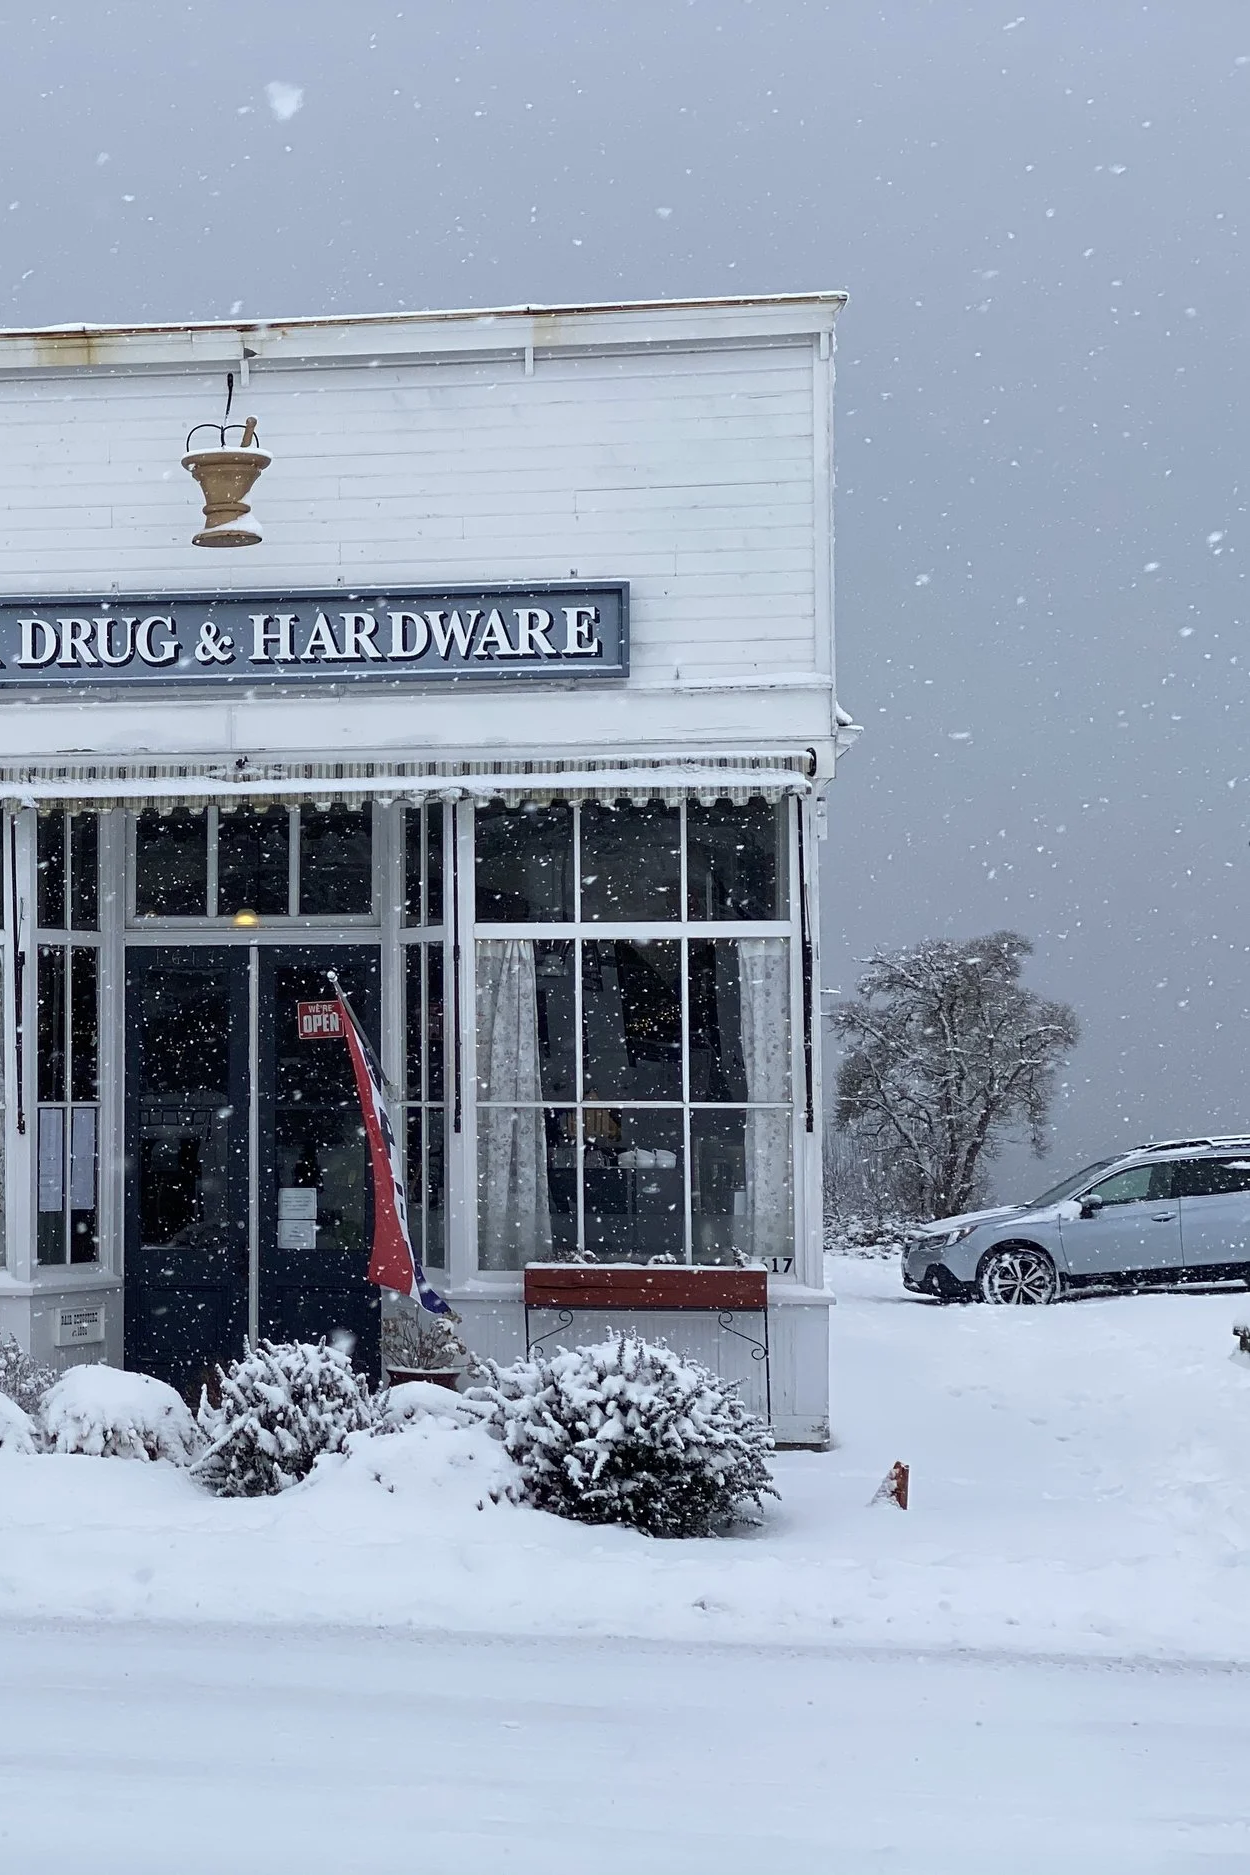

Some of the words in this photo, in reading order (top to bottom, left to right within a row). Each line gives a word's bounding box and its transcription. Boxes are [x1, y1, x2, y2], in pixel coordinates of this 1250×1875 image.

[17, 616, 182, 669] DRUG
[195, 621, 234, 665] &
[248, 606, 602, 664] HARDWARE
[308, 1004, 333, 1013] WE'RE
[303, 1013, 339, 1033] OPEN
[762, 1257, 794, 1273] 17
